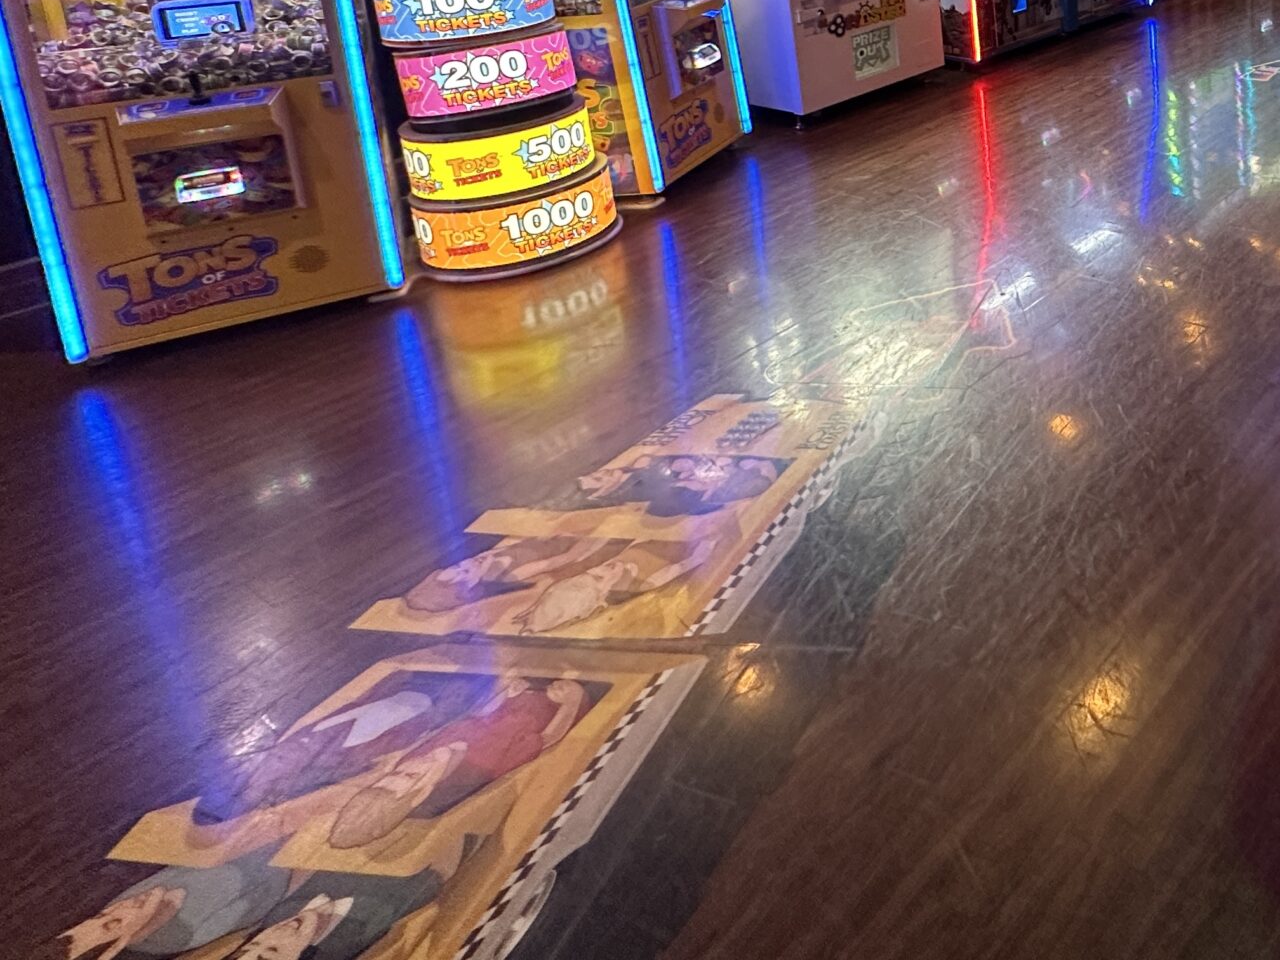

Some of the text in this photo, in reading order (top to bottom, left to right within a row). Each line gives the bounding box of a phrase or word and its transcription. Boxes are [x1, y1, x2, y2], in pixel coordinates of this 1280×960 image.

[415, 11, 508, 33] TICKETS
[852, 26, 890, 48] PRIZE
[440, 49, 528, 89] 200
[442, 79, 532, 107] TICKETS
[527, 121, 585, 163] 500
[447, 152, 500, 177] TONS
[500, 191, 595, 241] 1000
[440, 227, 486, 247] TONS
[513, 217, 593, 254] TICKETS
[107, 235, 257, 303] TONS
[201, 270, 226, 285] OF
